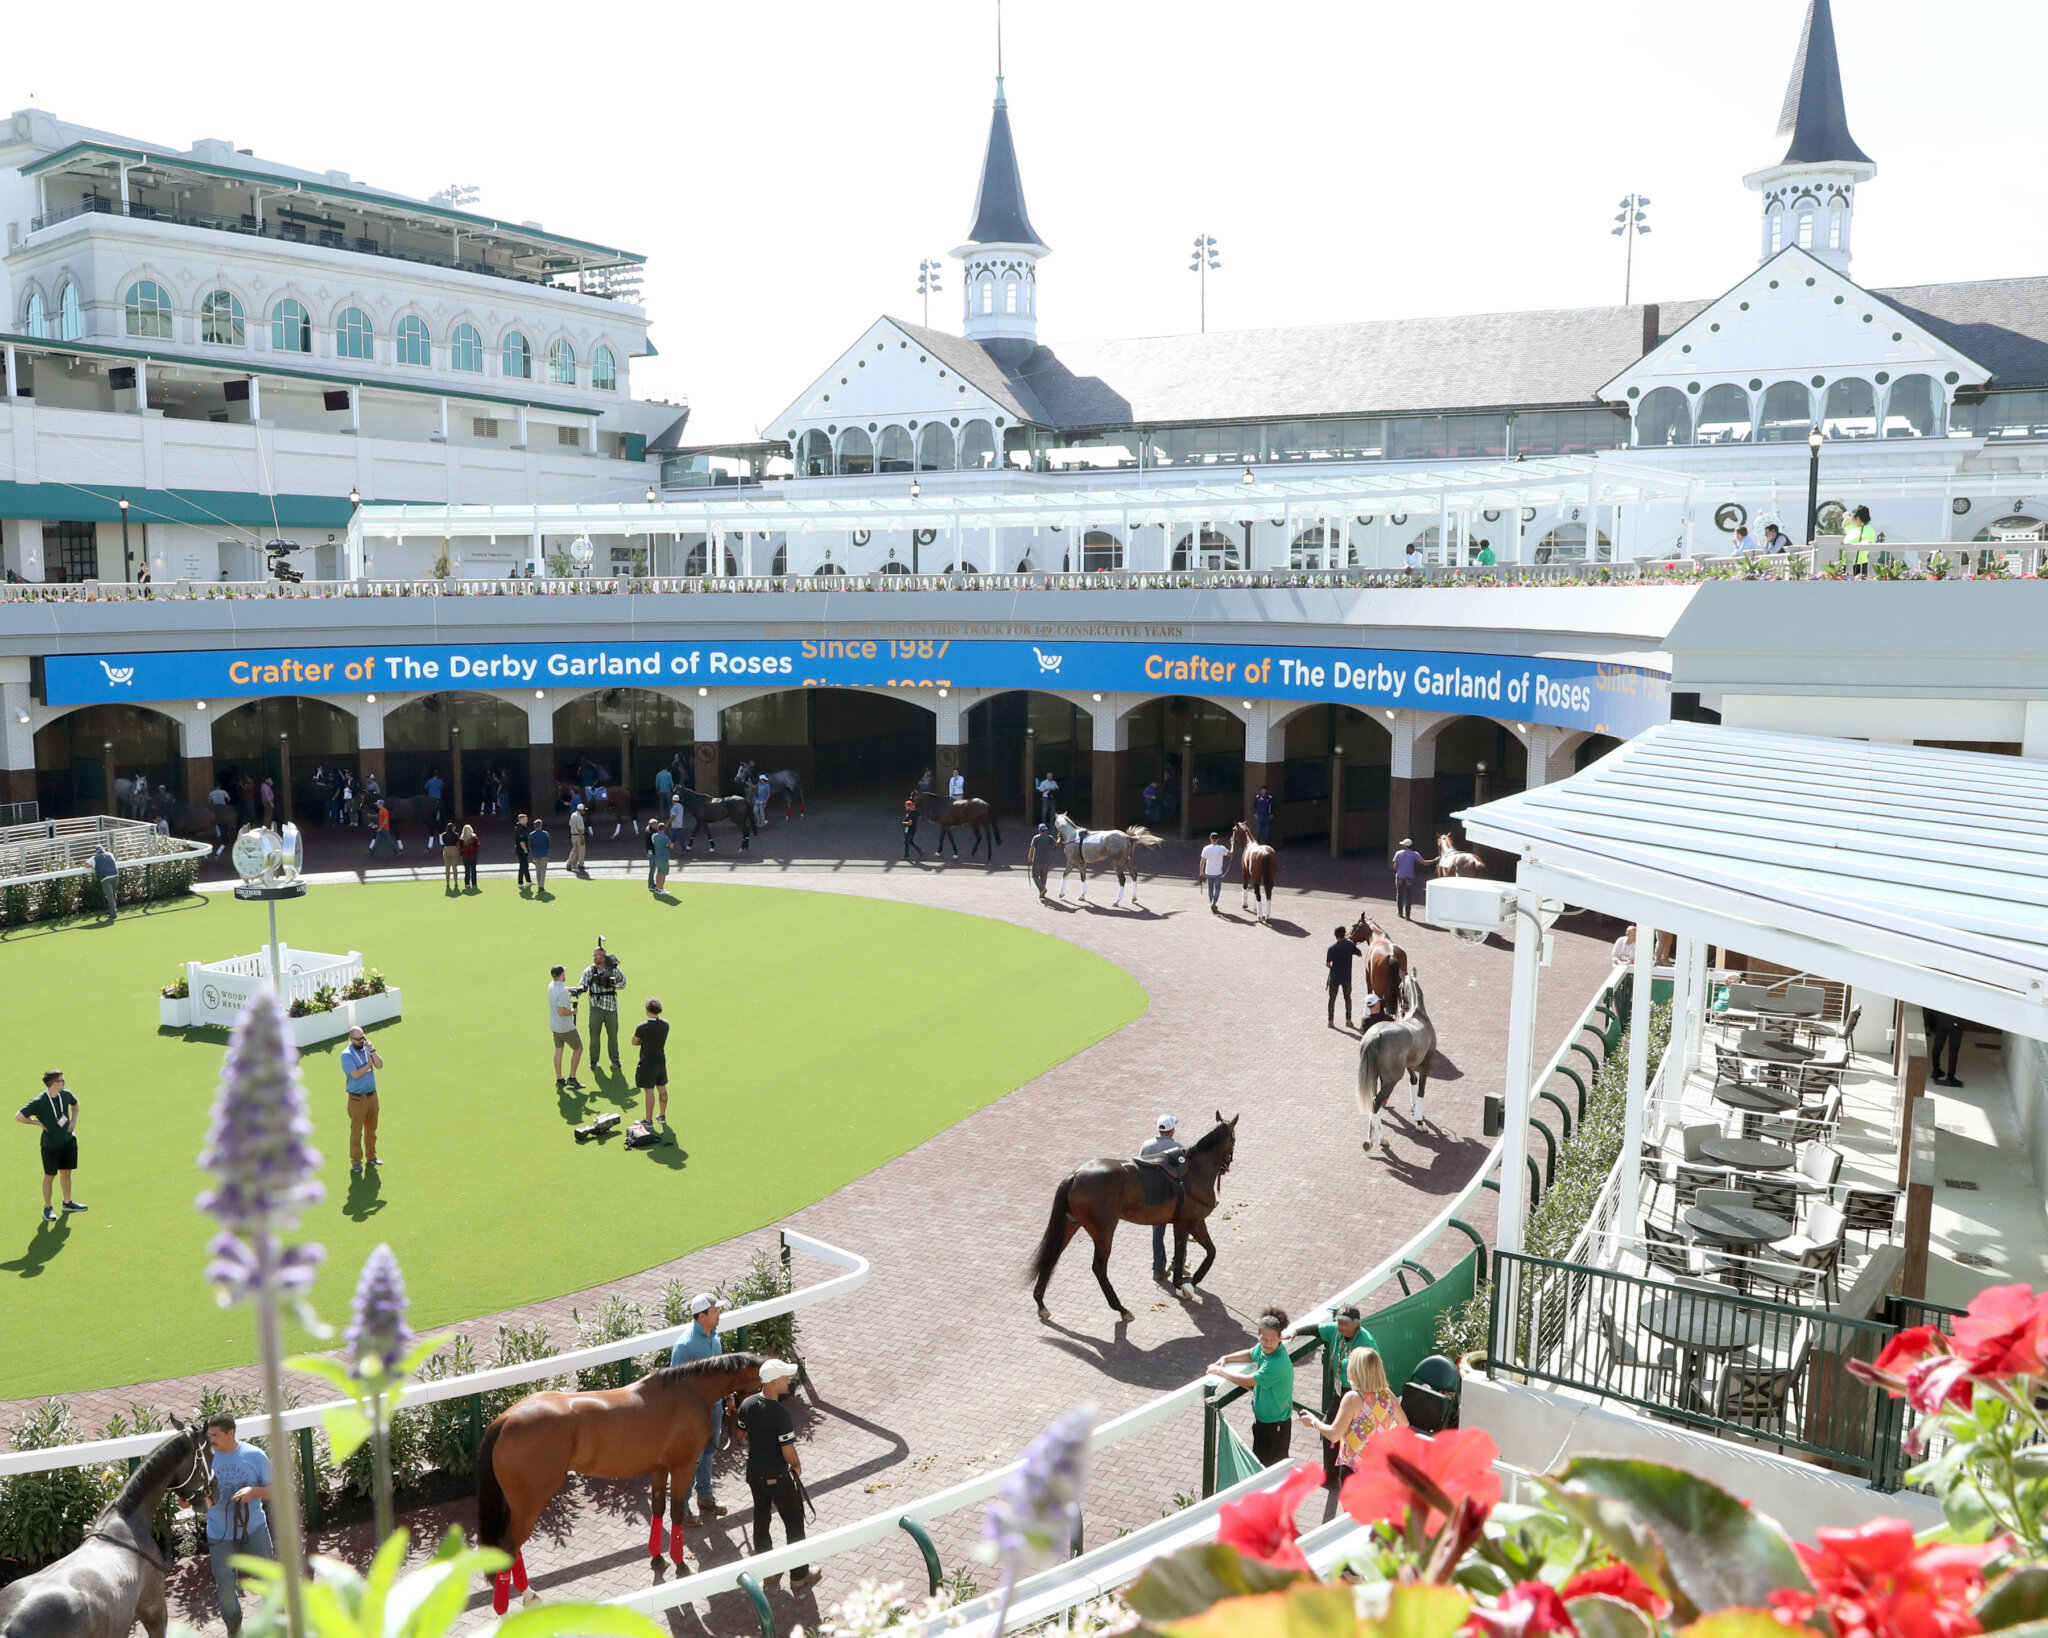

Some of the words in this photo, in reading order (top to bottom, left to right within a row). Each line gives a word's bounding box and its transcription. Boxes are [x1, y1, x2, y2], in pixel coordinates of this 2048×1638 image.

[880, 624, 905, 635] RUN
[908, 624, 926, 635] ON
[930, 624, 959, 635] THIS
[962, 624, 1003, 635] TRACK
[1006, 624, 1031, 635] FOR
[1057, 625, 1141, 636] CONSECUTIVE
[1144, 625, 1184, 637] YEARS
[801, 640, 877, 659] Since
[887, 640, 950, 659] 1987
[229, 658, 335, 684] Crafter
[344, 656, 376, 681] of
[384, 656, 440, 680] The
[450, 654, 538, 682] Derby
[547, 651, 661, 676] Garland
[670, 651, 701, 675] of
[710, 651, 793, 674] Roses
[1144, 654, 1237, 682] Crafter
[1244, 657, 1272, 684] of
[1278, 659, 1325, 688] The
[1334, 661, 1407, 698] Derby
[1413, 665, 1501, 701] Garland
[1507, 671, 1531, 704] of
[1535, 674, 1591, 713] Roses
[221, 990, 248, 1001] WOODF
